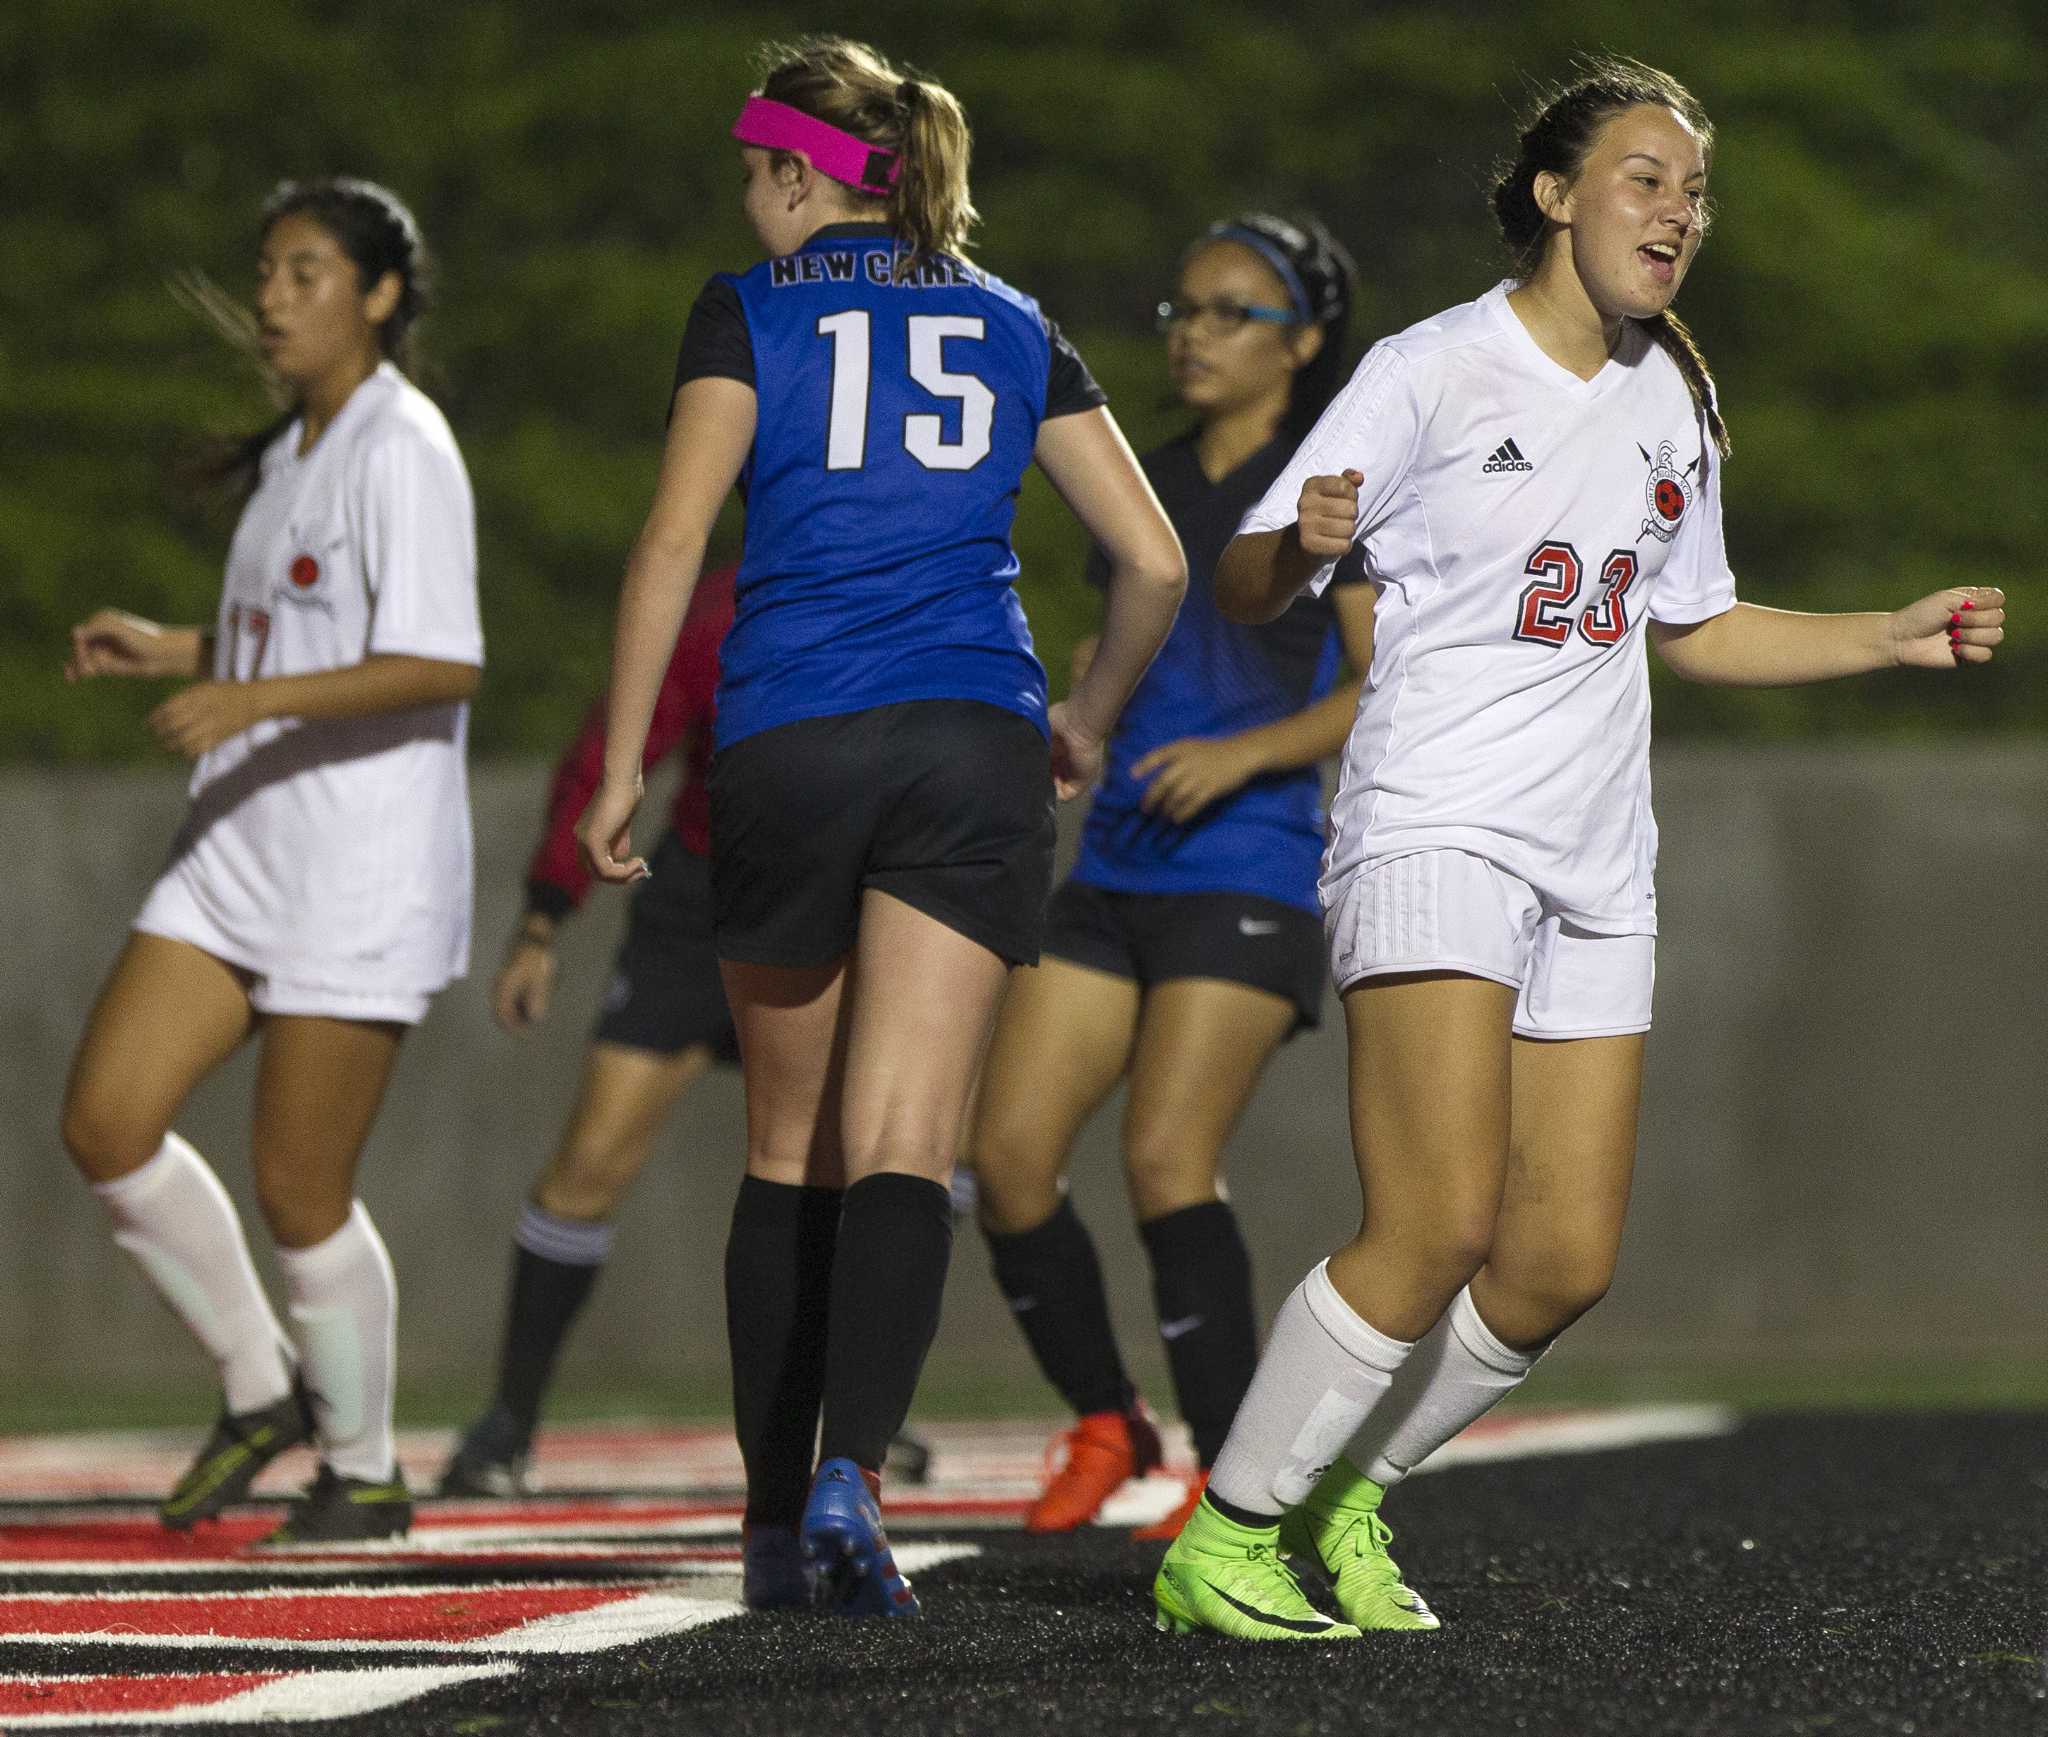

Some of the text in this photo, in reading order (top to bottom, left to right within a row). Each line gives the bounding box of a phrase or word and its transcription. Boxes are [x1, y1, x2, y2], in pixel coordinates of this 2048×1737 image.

[770, 252, 857, 288] NEW
[817, 309, 996, 471] 15
[1482, 459, 1533, 474] adidas
[1511, 539, 1639, 649] 23
